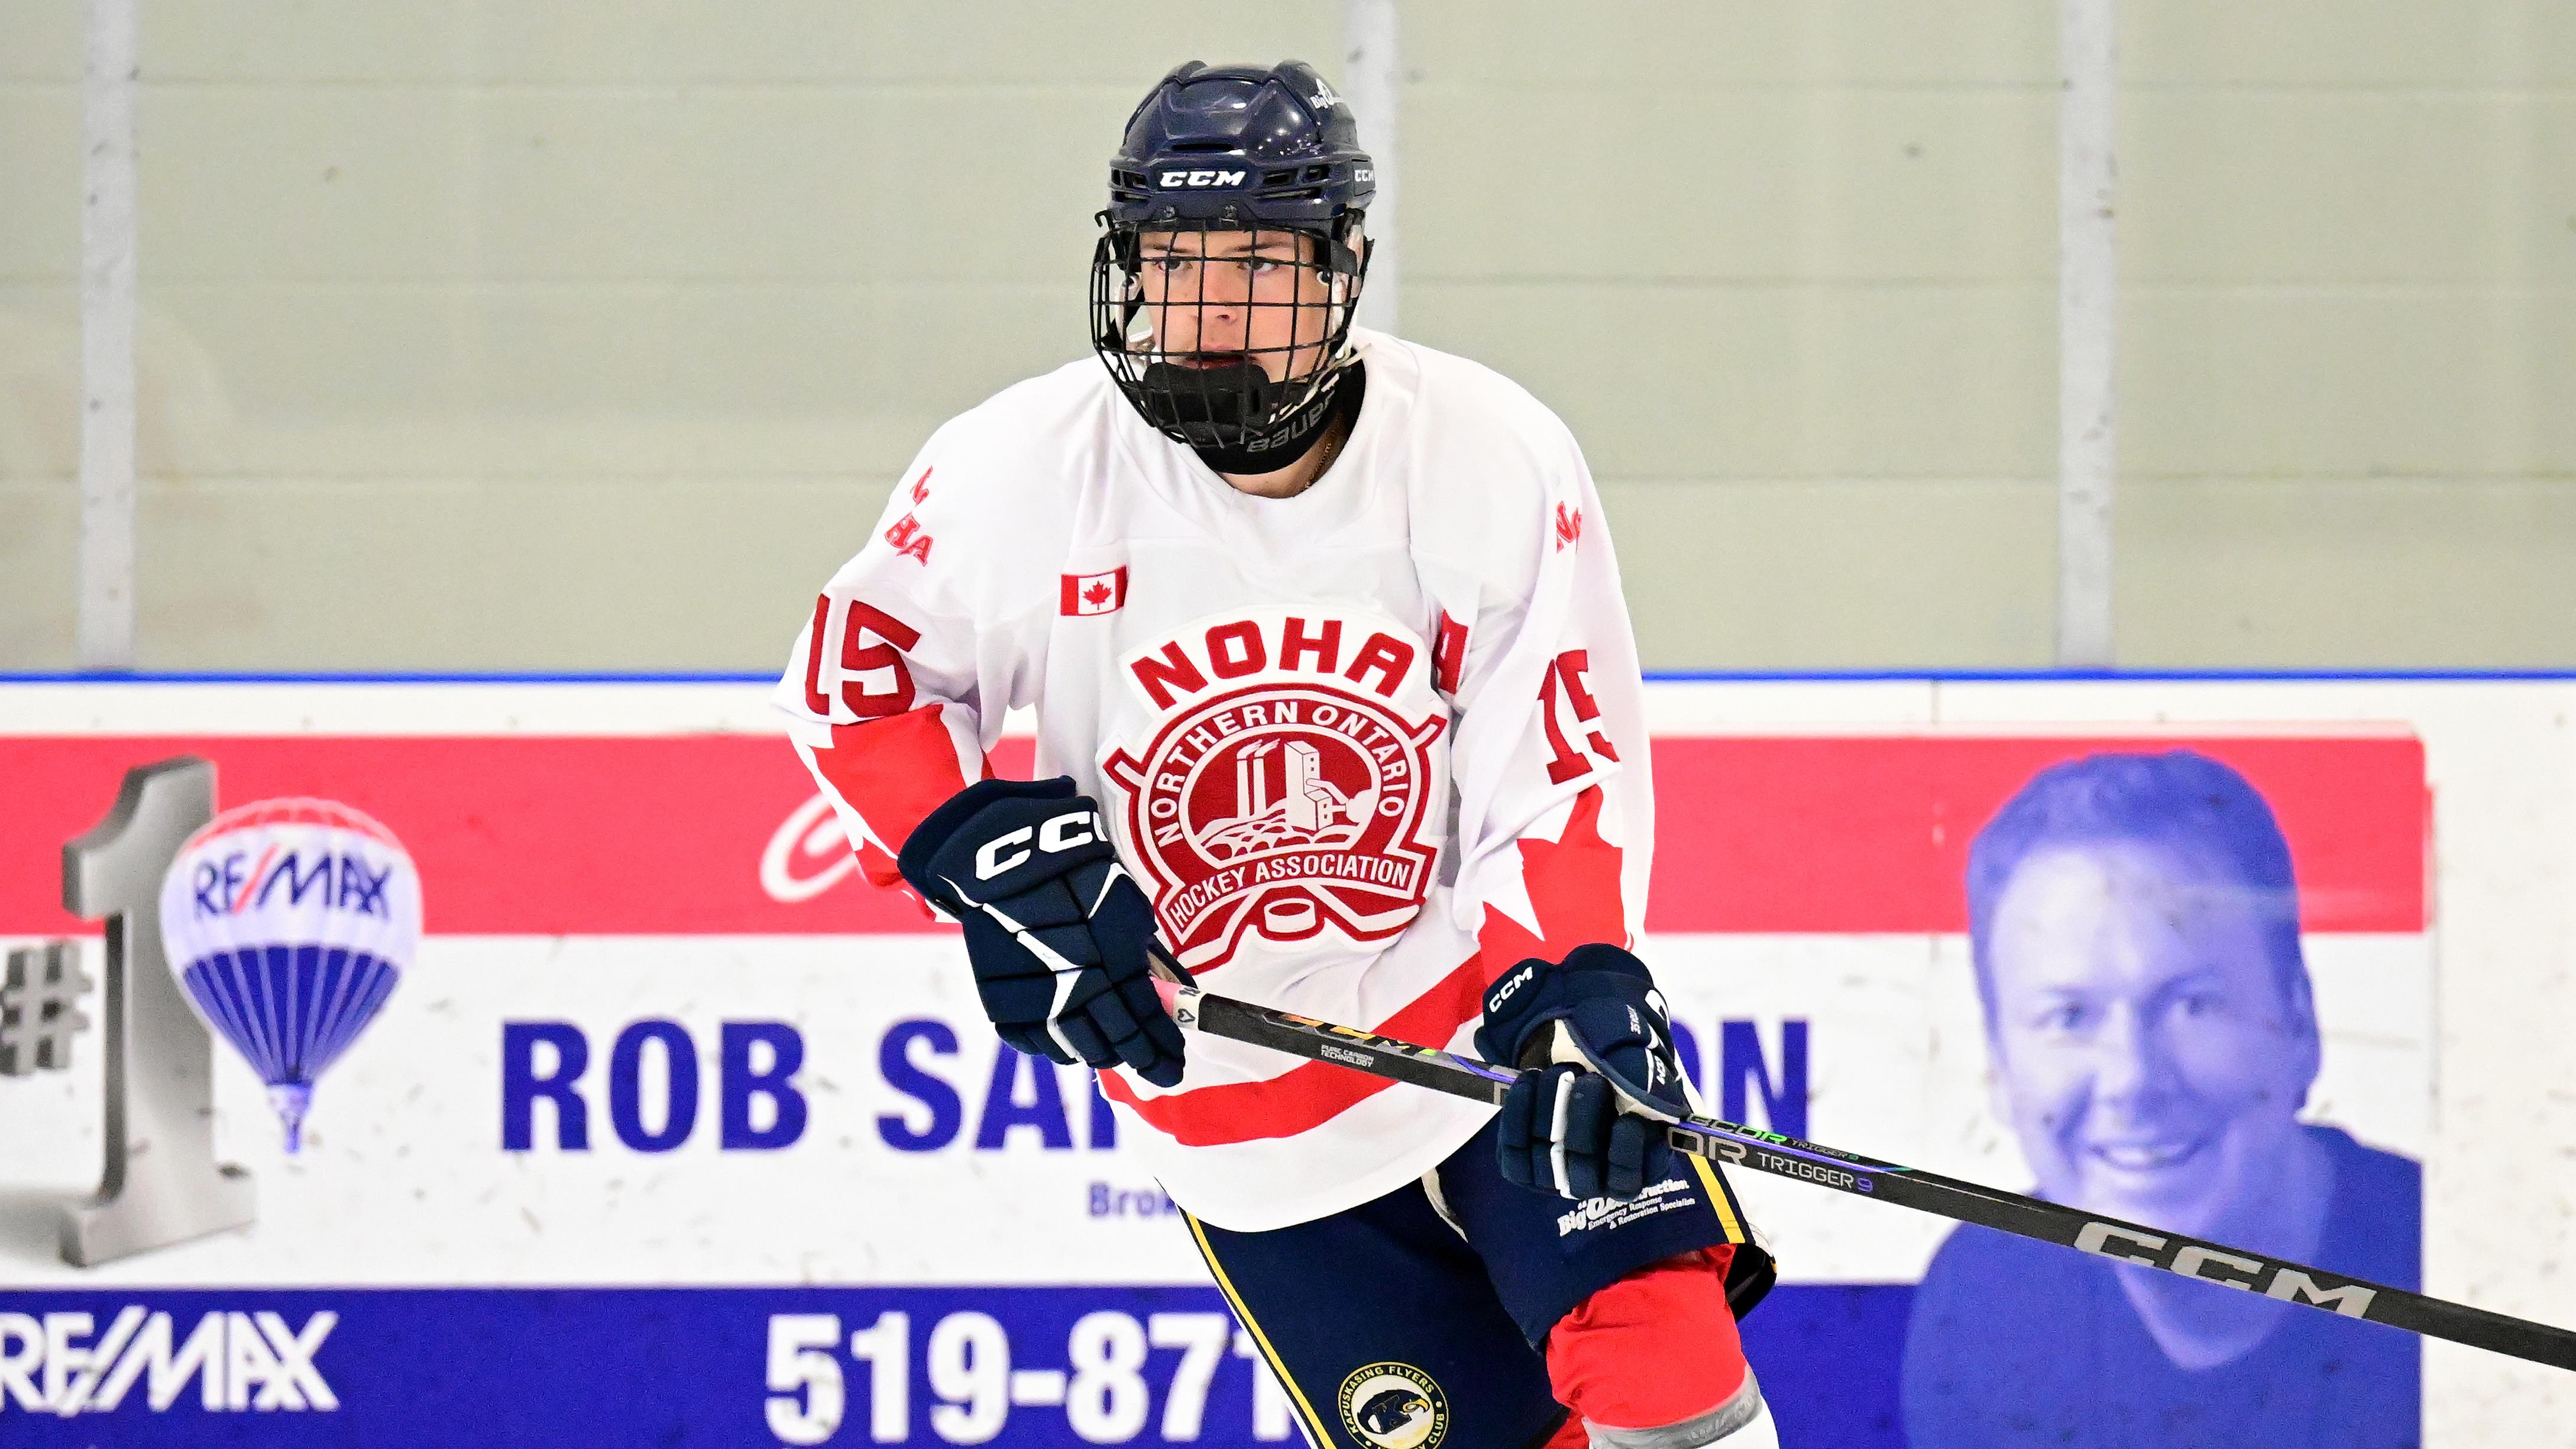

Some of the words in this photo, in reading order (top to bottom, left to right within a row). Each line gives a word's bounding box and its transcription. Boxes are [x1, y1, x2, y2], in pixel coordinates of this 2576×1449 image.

[1159, 170, 1246, 187] CCM
[805, 592, 923, 718] 15
[1130, 616, 1415, 711] NOHA
[1150, 701, 1298, 848] NORTHERN
[1312, 704, 1410, 817] ONTARIO
[975, 810, 1109, 881] CC
[194, 843, 393, 921] RE/MAX
[1170, 867, 1246, 929] HOCKEY
[1255, 854, 1411, 888] ASSOCIATION
[1488, 966, 1533, 1013] CCM
[501, 1018, 808, 1153] ROB
[875, 1017, 1118, 1154] SA
[1321, 1049, 1373, 1068] TECHNOLOGY
[1757, 1151, 1854, 1190] TRIGGER
[1557, 1209, 1586, 1237] Big
[1588, 1207, 1627, 1231] Emergency
[1629, 1196, 1663, 1212] Response
[1618, 1205, 1659, 1226] Restoration
[1660, 1196, 1696, 1212] Specialists
[2073, 1220, 2378, 1319] CCM
[0, 1305, 340, 1418] RE/MAX
[764, 1309, 1293, 1444] 519-871
[1341, 1366, 1385, 1434] KAPUSKASING
[1389, 1366, 1435, 1393] FLYERS
[1428, 1413, 1445, 1444] CLUB
